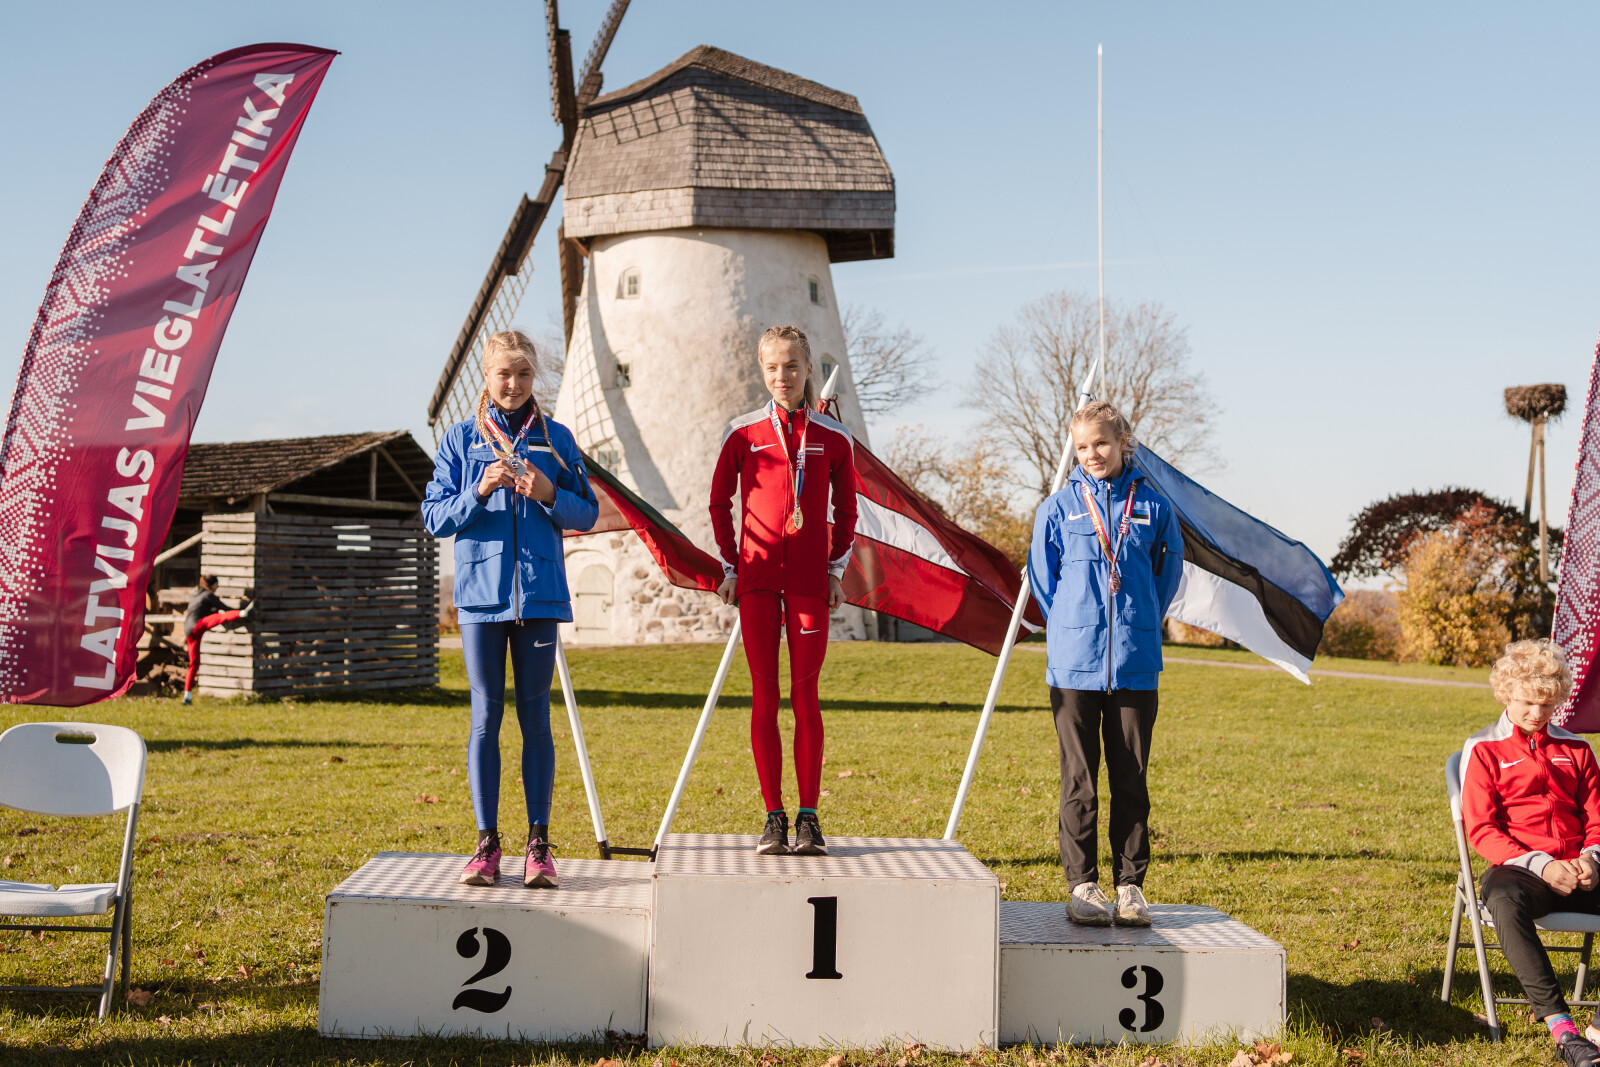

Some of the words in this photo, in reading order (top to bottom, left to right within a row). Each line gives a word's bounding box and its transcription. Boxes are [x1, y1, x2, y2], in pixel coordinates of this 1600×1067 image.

[74, 448, 154, 690] LATVIJAS
[126, 73, 295, 431] VIEGLATLĒTIKA
[452, 927, 513, 1013] 2
[806, 896, 843, 979] 1
[1118, 965, 1165, 1033] 3
